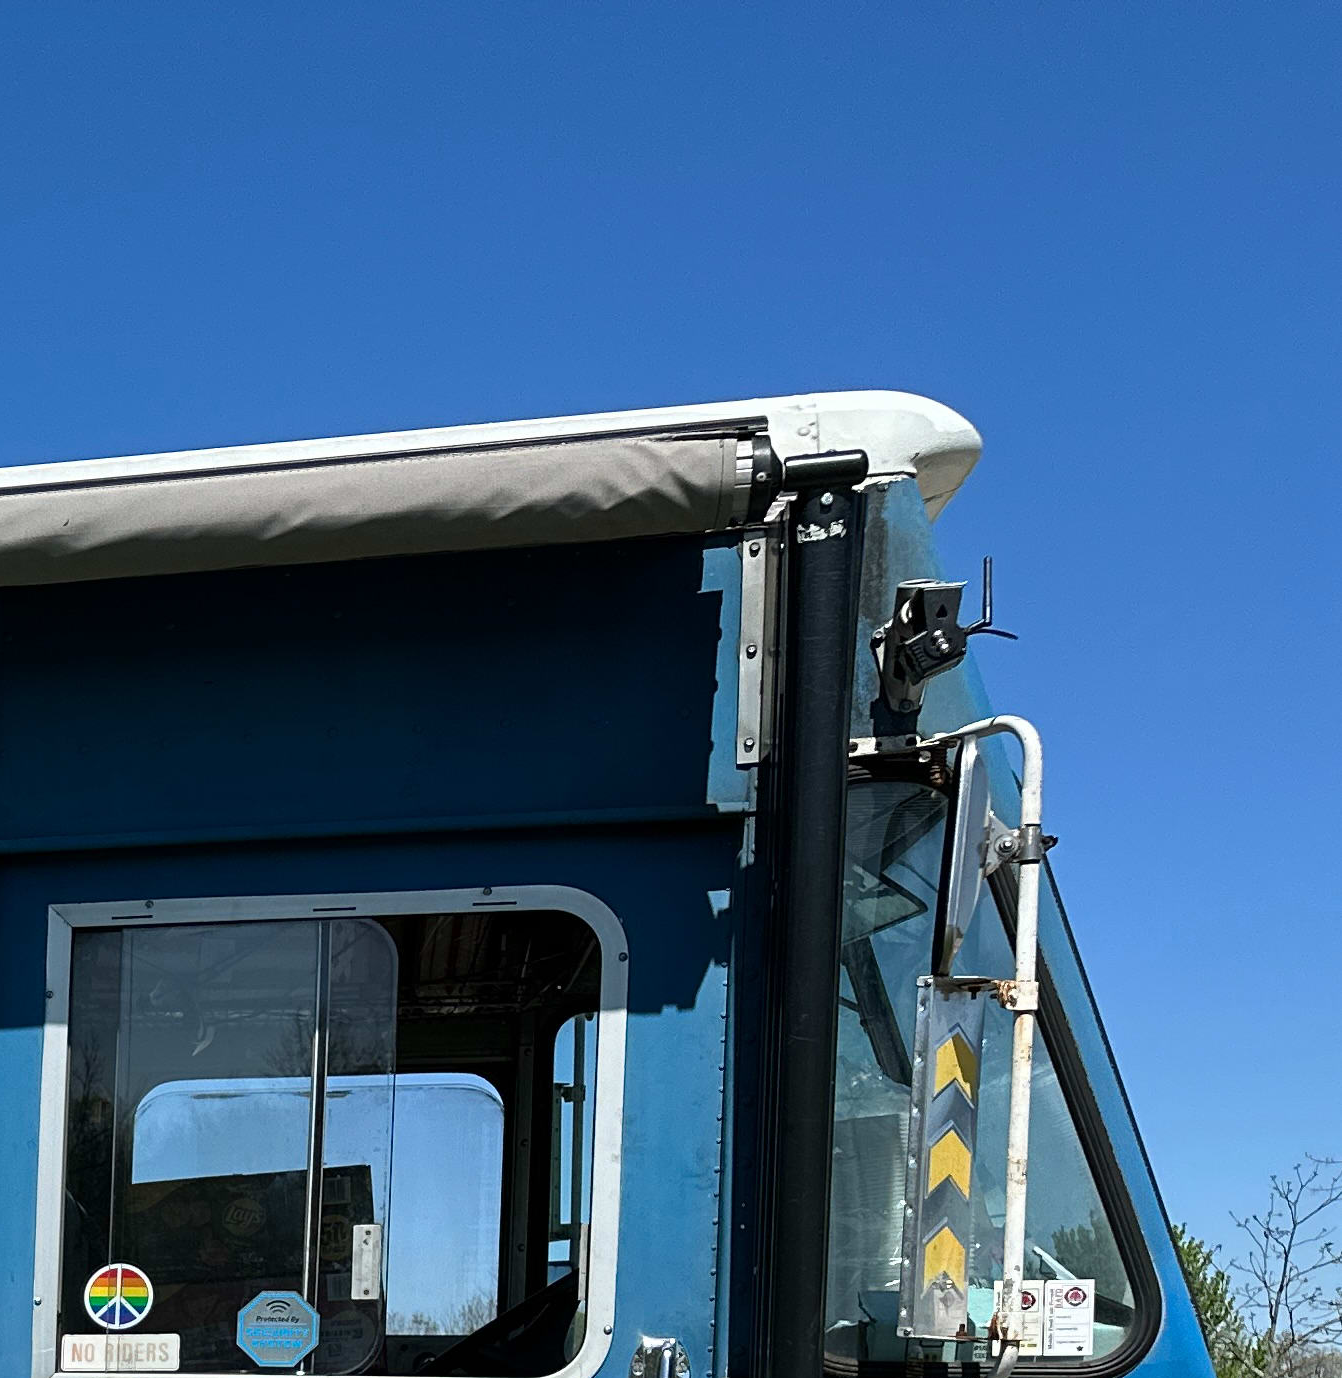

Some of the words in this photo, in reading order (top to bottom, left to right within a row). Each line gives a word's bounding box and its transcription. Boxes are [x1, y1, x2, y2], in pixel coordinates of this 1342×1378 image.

[290, 1315, 300, 1323] By
[71, 1342, 95, 1362] NO
[104, 1342, 170, 1363] RIDERS
